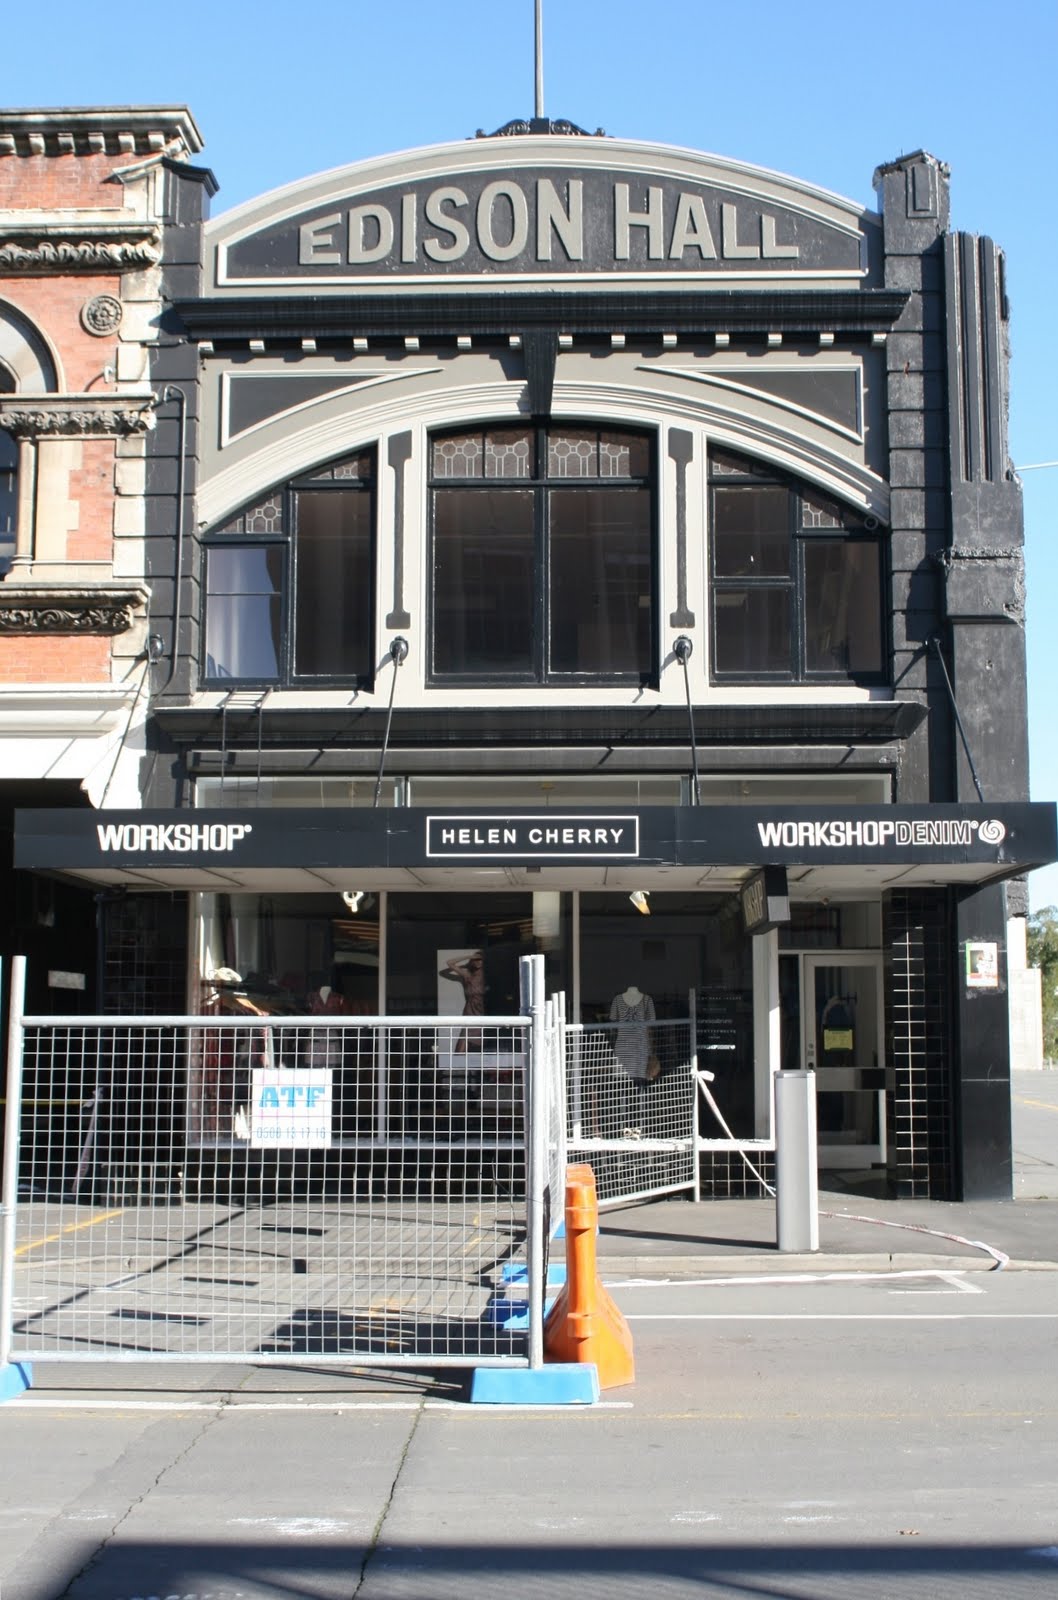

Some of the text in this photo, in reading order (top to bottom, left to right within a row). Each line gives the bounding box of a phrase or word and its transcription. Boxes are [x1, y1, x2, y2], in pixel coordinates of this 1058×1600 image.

[297, 179, 800, 263] EDISON HALL
[442, 828, 624, 844] HELEN CHERRY
[259, 1086, 326, 1108] ATF
